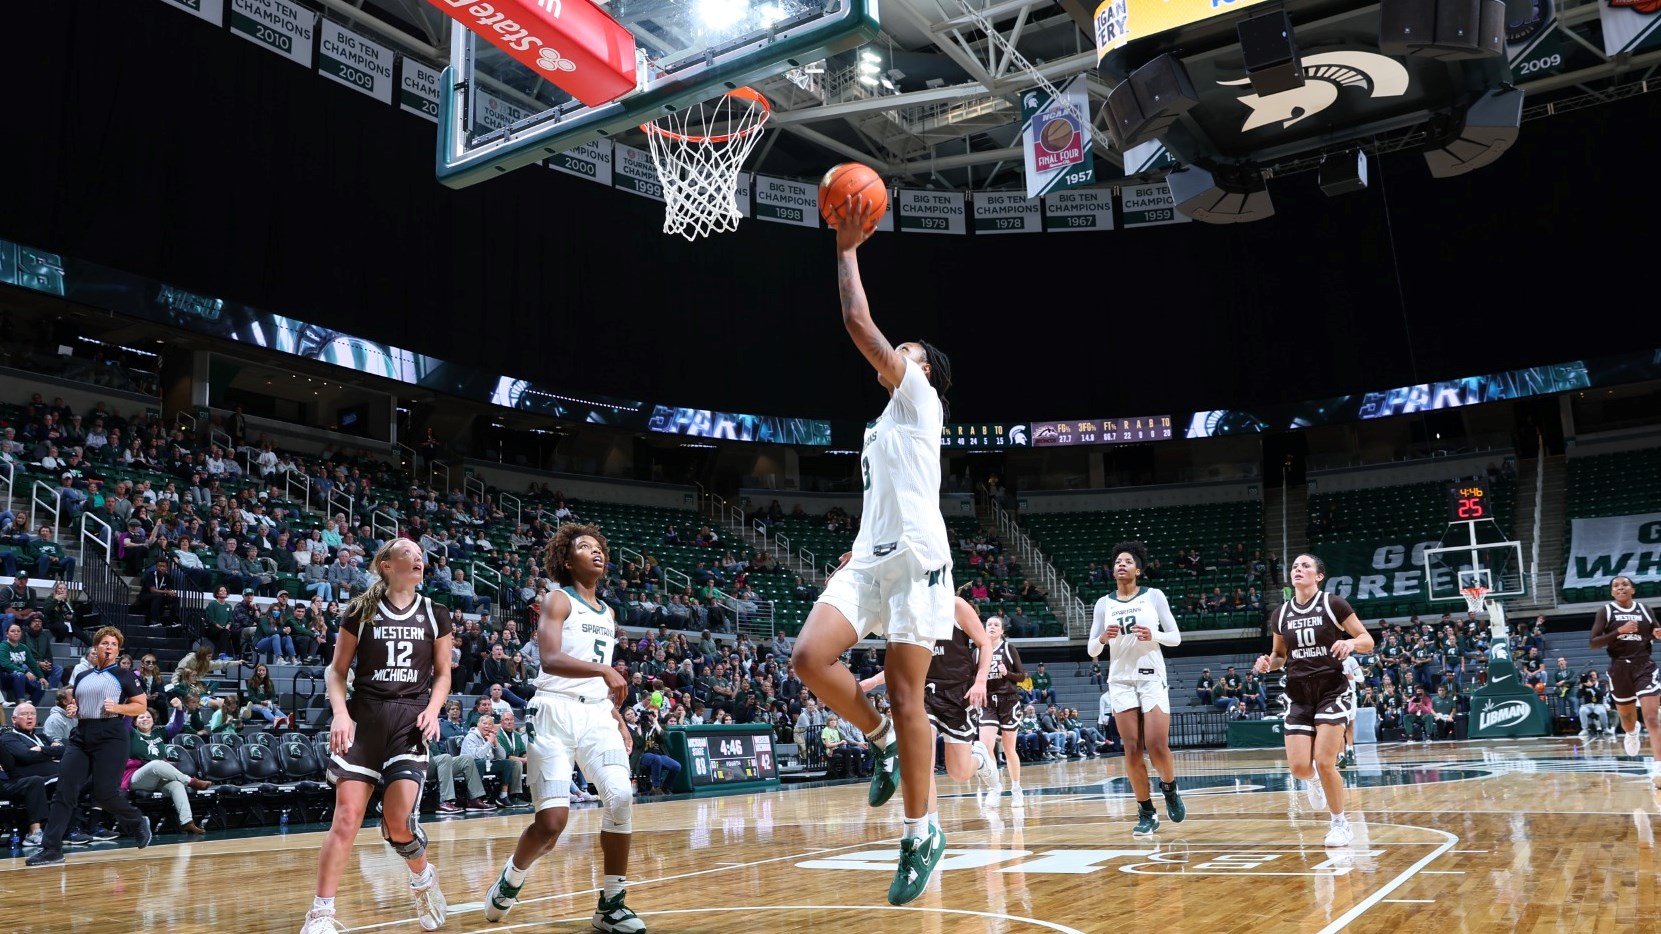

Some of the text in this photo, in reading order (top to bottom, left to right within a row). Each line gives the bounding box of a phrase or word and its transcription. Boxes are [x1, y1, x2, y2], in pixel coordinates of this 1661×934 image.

[276, 1, 297, 20] TEN
[235, 0, 311, 40] CHAMPIONS
[256, 25, 289, 49] 2010
[337, 32, 379, 60] BIG TEN
[323, 40, 391, 78] CHAMPIONS
[1520, 54, 1561, 74] 2009
[339, 65, 373, 88] 2009
[417, 69, 434, 85] BIG
[1042, 109, 1069, 121] NCAA
[1038, 153, 1058, 166] FINAL
[1060, 148, 1079, 161] FOUR
[565, 158, 595, 174] 2000
[1065, 169, 1093, 185] 1957
[634, 179, 661, 197] 1999
[769, 182, 806, 196] BIG TEN
[1136, 187, 1153, 197] BIG
[758, 191, 817, 208] CHAMPIONS
[913, 194, 951, 204] BIG TEN
[987, 194, 1026, 205] BIG TEN
[1059, 193, 1098, 202] BIG TEN
[775, 207, 801, 220] 1998
[902, 204, 963, 215] CHAMPIONS
[976, 204, 1039, 215] CHAMPIONS
[1048, 203, 1111, 213] CHAMPIONS
[1144, 210, 1171, 221] 1959
[921, 218, 946, 229] 1979
[995, 218, 1021, 229] 1978
[1067, 216, 1093, 227] 1967
[1359, 361, 1592, 420] SPARTANS
[648, 404, 832, 446] SPARTANS
[958, 426, 963, 435] R
[970, 426, 976, 435] A
[982, 426, 987, 434] B
[994, 426, 1003, 434] TO
[1057, 418, 1170, 433] FG% 3FG% FT% R A B TO
[996, 437, 1004, 445] 15
[1059, 434, 1072, 443] 27.7
[1123, 432, 1131, 440] 22
[1163, 429, 1171, 437] 20
[1459, 488, 1483, 497] 4:46
[1458, 498, 1483, 518] 25
[1372, 541, 1444, 570] GO
[1116, 615, 1137, 635] 12
[1287, 616, 1323, 630] WESTERN
[1615, 614, 1643, 622] WESTERN
[373, 626, 425, 640] WESTERN
[1295, 628, 1316, 648] 10
[385, 641, 413, 667] 12
[592, 638, 607, 664] 5
[1291, 646, 1328, 660] MICHIGAN
[371, 668, 419, 683] MICHIGAN
[1479, 704, 1525, 731] LIBMAN
[720, 739, 743, 755] 4:46
[761, 754, 772, 770] 42
